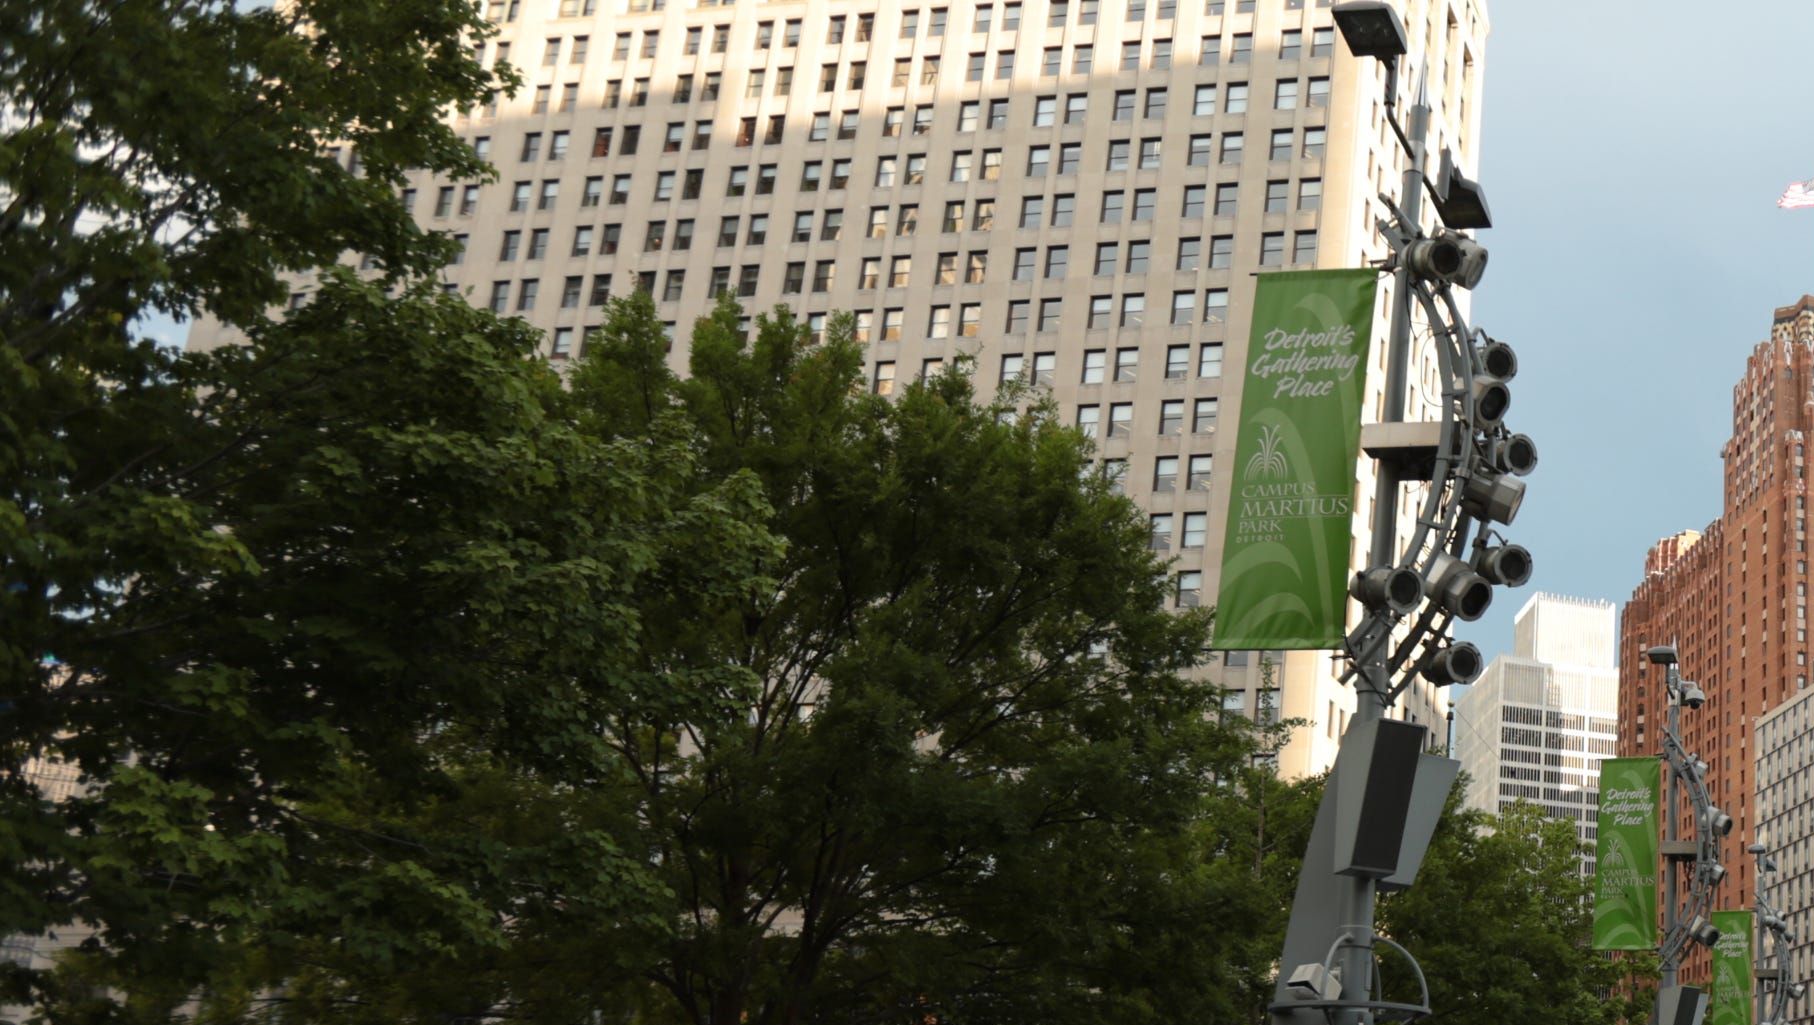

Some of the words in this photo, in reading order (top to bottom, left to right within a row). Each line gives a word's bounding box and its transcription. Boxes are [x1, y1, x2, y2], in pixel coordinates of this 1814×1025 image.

[1263, 324, 1356, 351] Detroit's
[1251, 348, 1360, 381] Gathering
[1273, 374, 1334, 399] Place
[1240, 481, 1316, 498] CAMPUS
[1240, 497, 1349, 518] MARTIUS
[1238, 518, 1283, 534] PARK
[1235, 534, 1285, 544] DETROIT
[1606, 787, 1652, 800] Detroit's
[1601, 800, 1655, 818] Gathering
[1612, 813, 1644, 827] Place
